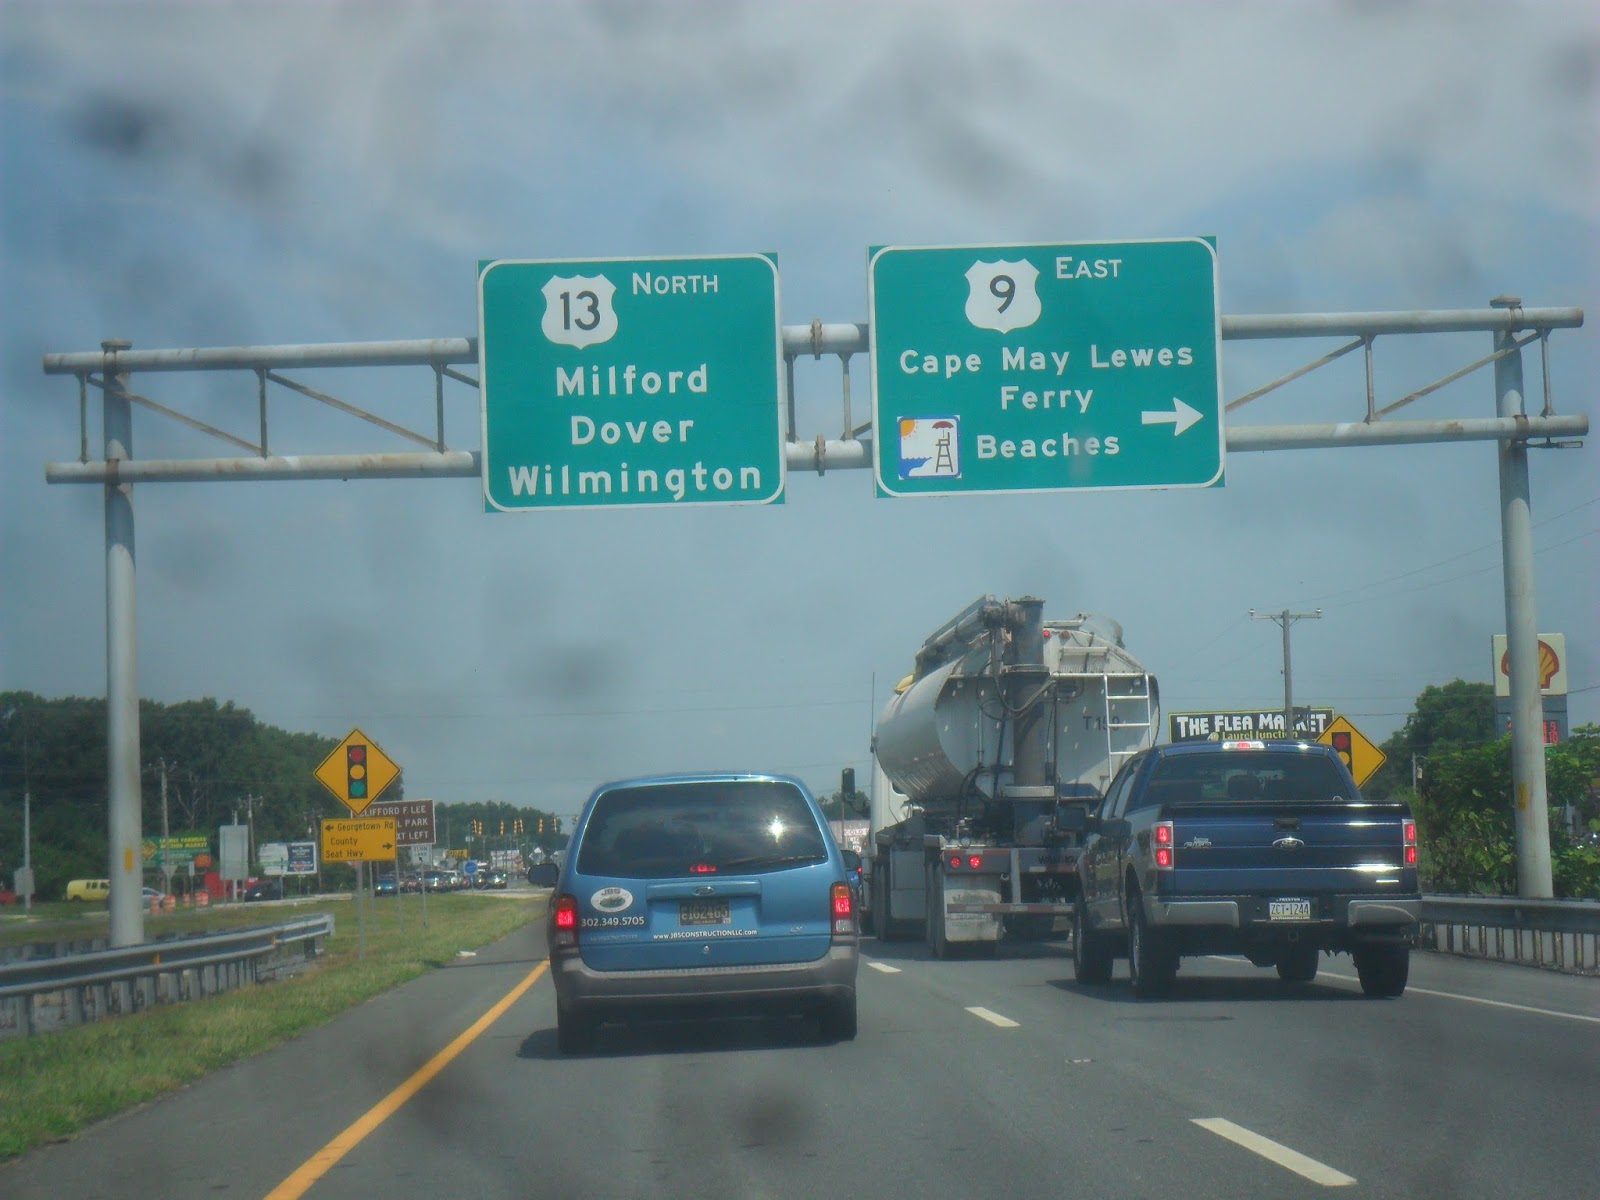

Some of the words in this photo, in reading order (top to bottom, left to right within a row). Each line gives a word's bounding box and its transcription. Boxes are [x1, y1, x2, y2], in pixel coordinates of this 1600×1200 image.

[989, 274, 1016, 314] 9
[559, 290, 601, 331] 13
[900, 350, 982, 379] Cape
[1002, 346, 1070, 376] May
[1091, 344, 1194, 369] Lewes
[556, 363, 708, 397] Milford
[1001, 386, 1093, 413] Ferry
[571, 415, 694, 445] Dover
[977, 432, 1120, 459] Beaches
[508, 461, 761, 501] Wilmington
[1176, 716, 1210, 738] THE
[1214, 714, 1253, 732] FLEA
[1258, 713, 1327, 734] MAET
[1222, 729, 1253, 741] Laurel
[1256, 729, 1298, 740] Junctin
[410, 805, 427, 814] LEE
[337, 822, 381, 832] Georgetown
[384, 820, 394, 830] Rd
[405, 818, 428, 827] PARK
[330, 837, 358, 846] County
[409, 831, 428, 840] LEFT
[325, 850, 343, 858] Seat
[346, 849, 364, 858] Hwy
[581, 916, 645, 927] 302.349.5705
